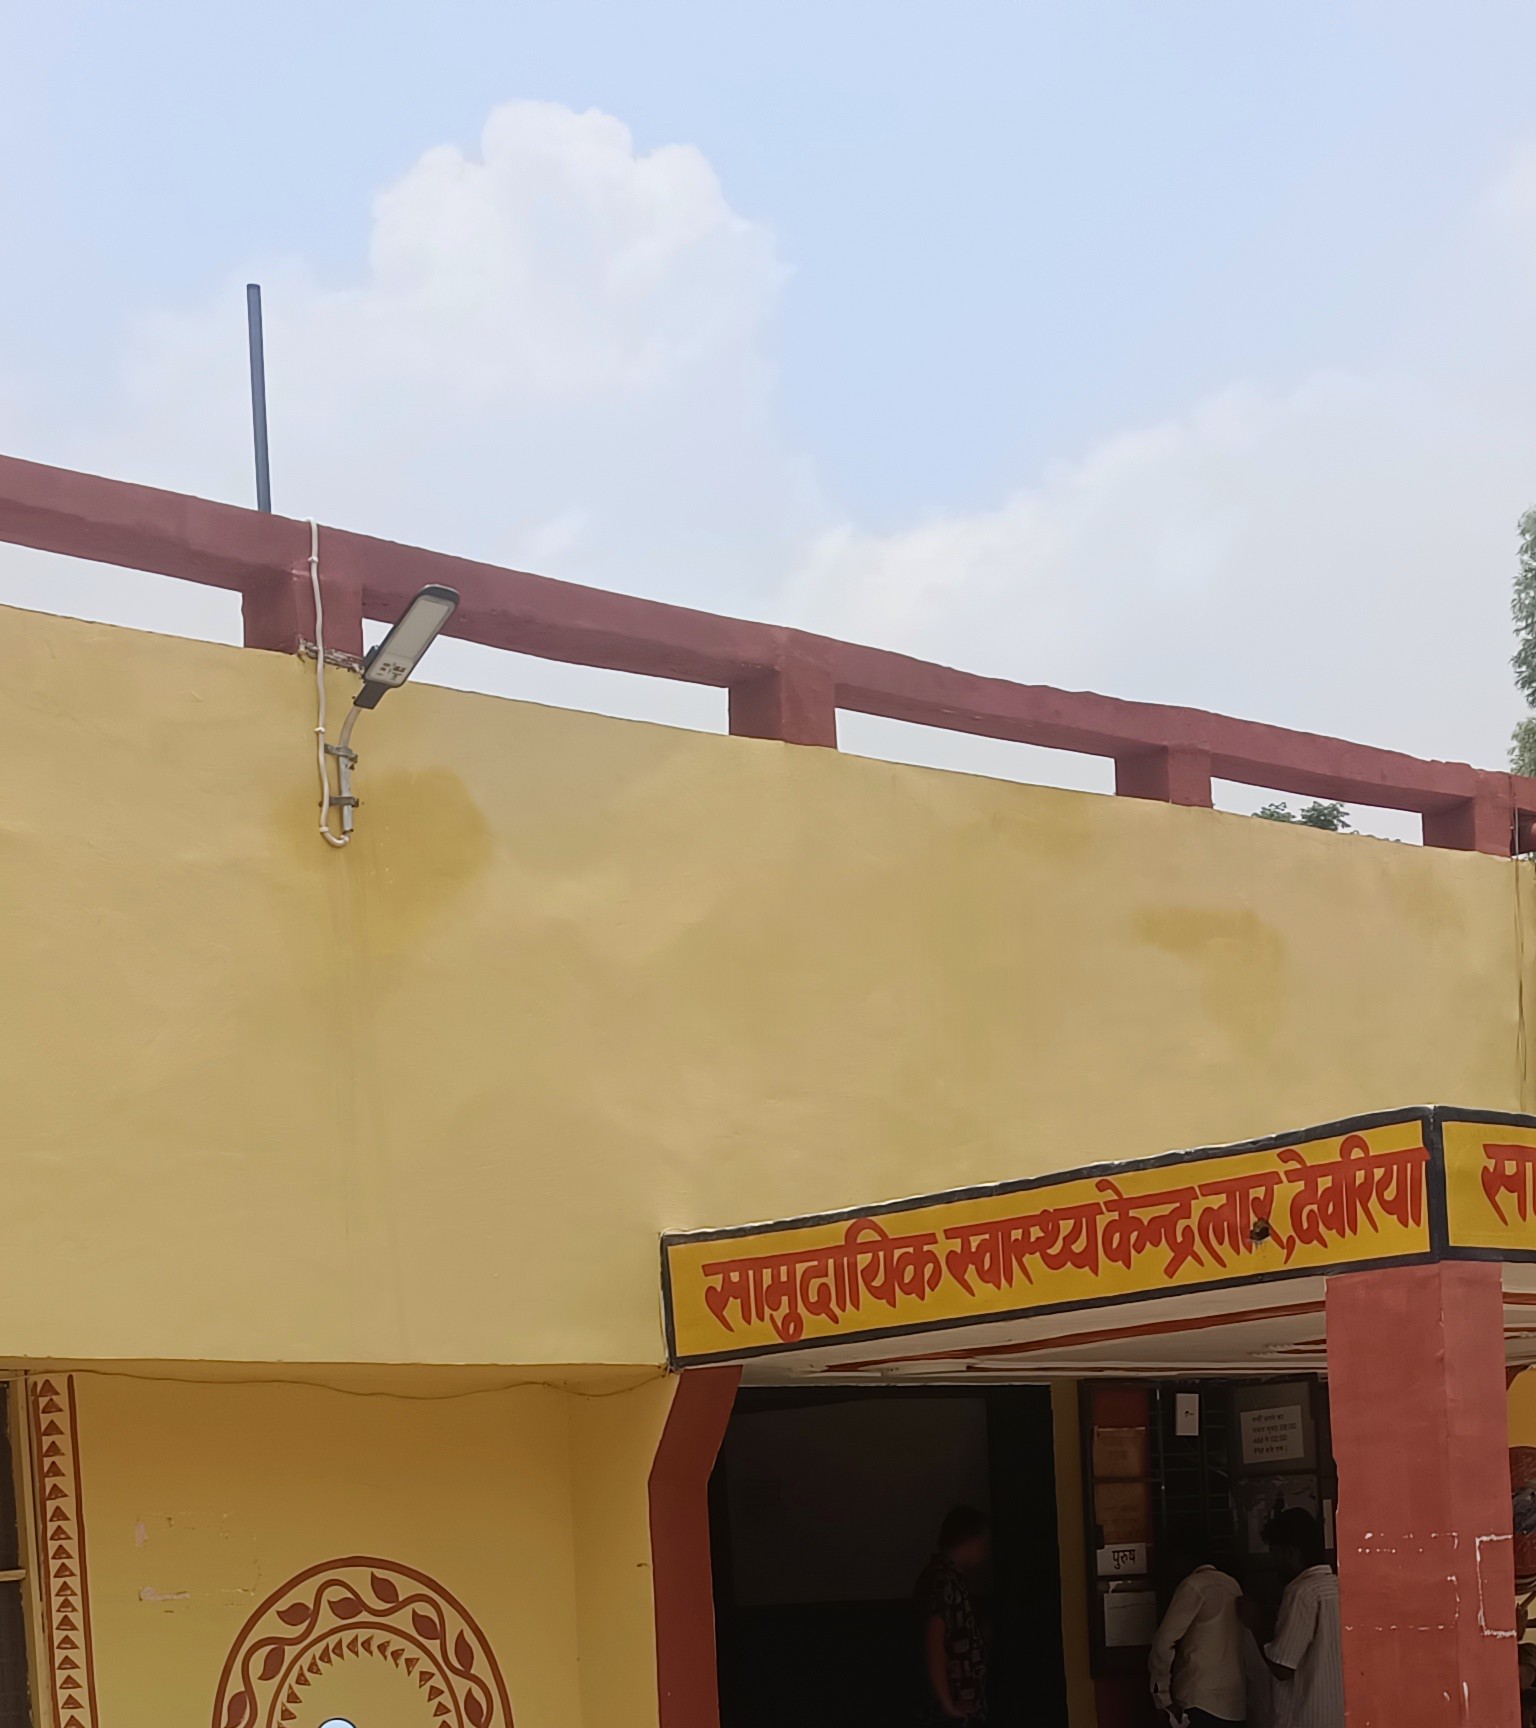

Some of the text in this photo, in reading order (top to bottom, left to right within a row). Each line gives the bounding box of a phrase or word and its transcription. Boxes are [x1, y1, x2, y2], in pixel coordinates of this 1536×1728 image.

[702, 1217, 943, 1342] सामुदायिक
[945, 1199, 1105, 1298] स्वास्थ्य
[1095, 1178, 1201, 1279] केन्द्र
[1278, 1133, 1431, 1247] देवरिया
[1112, 1549, 1136, 1571] पुरुष
